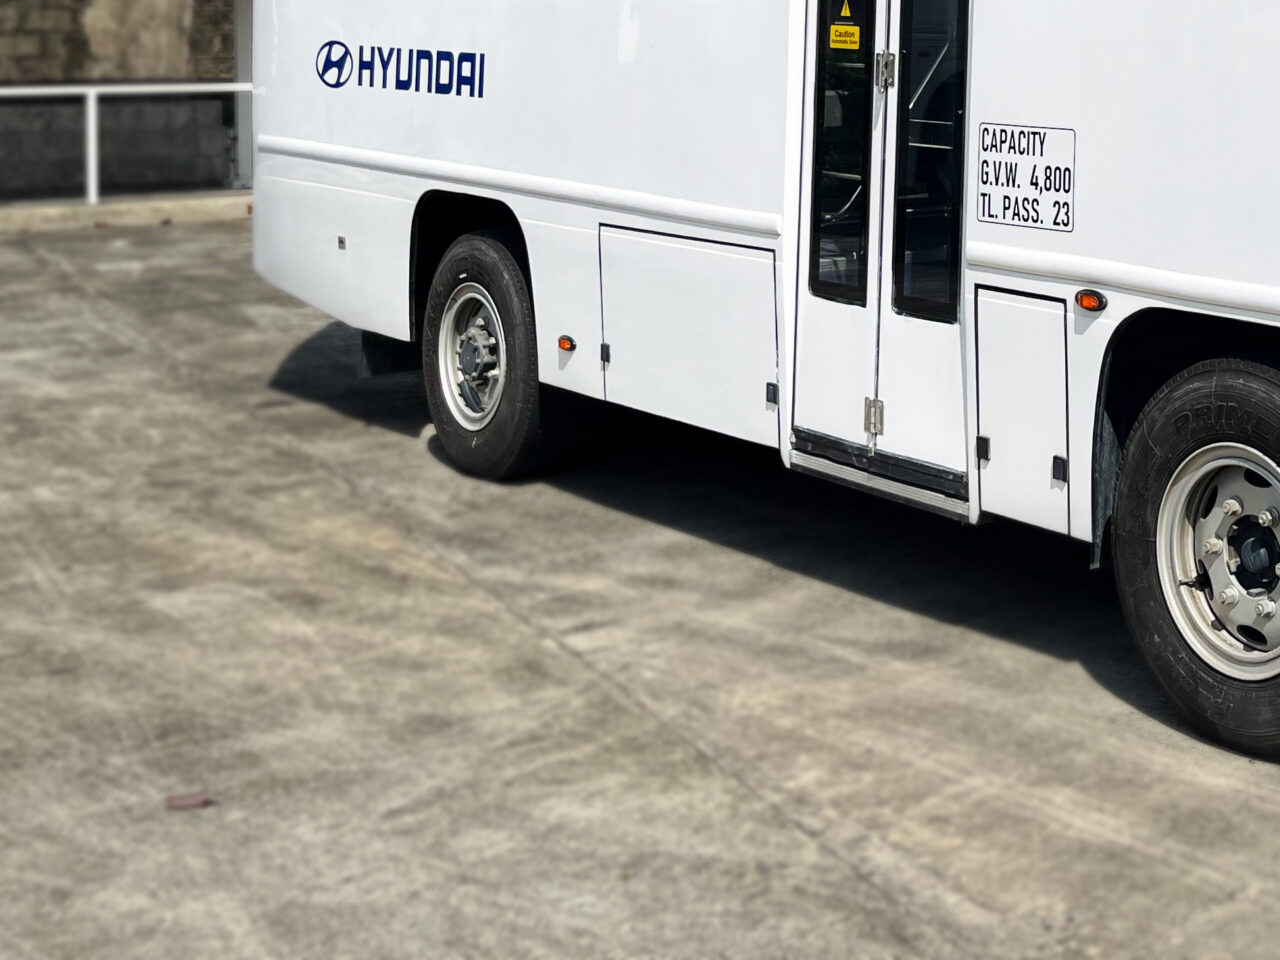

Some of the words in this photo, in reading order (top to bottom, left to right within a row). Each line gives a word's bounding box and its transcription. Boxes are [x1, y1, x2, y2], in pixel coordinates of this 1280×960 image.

[834, 29, 856, 39] Caution
[358, 45, 485, 98] HYUNDAI
[981, 127, 1047, 157] CAPACITY
[980, 160, 1020, 188] G.V.W.
[1029, 164, 1071, 195] 4,800
[980, 192, 998, 219] TL.
[1002, 195, 1044, 224] PASS.
[1053, 200, 1070, 227] 23
